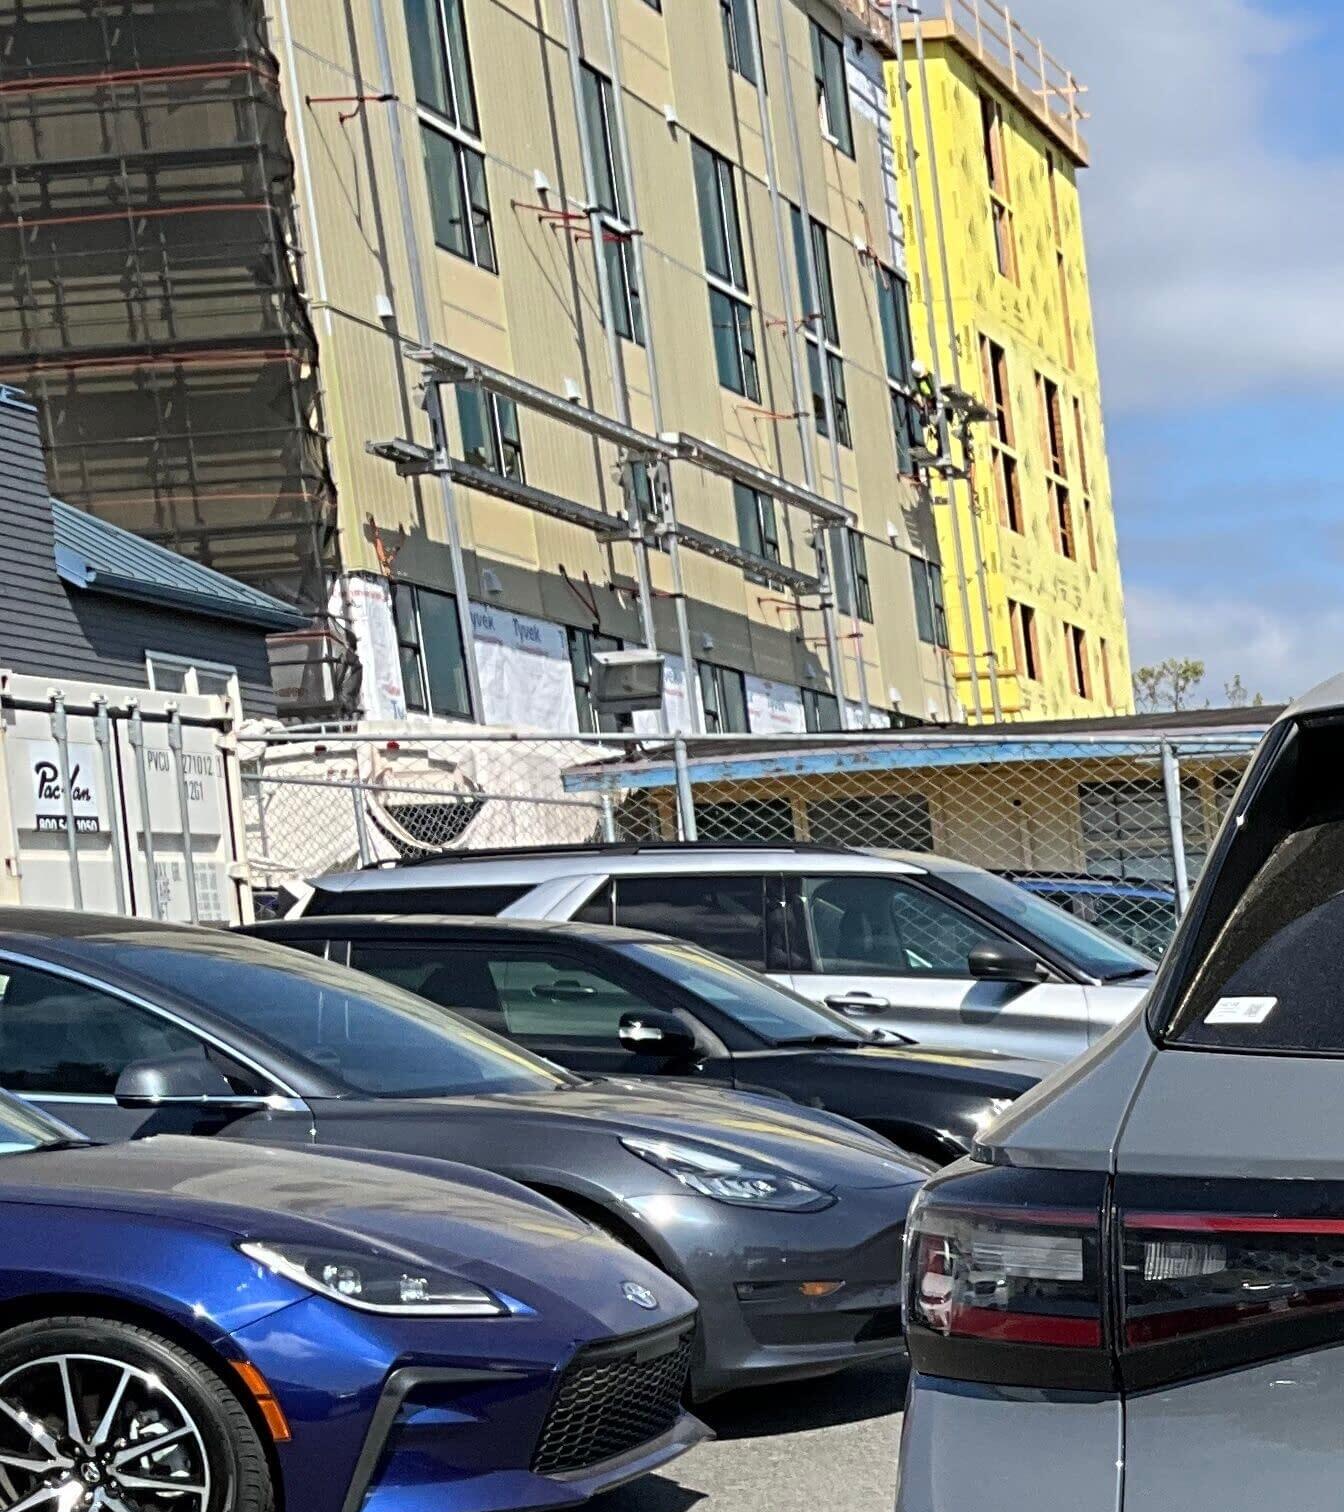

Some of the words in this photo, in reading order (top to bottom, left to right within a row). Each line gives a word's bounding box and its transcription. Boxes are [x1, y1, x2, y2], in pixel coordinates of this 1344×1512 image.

[470, 611, 496, 631] yvek
[512, 618, 542, 643] Tyvek
[147, 750, 170, 772] PVCU
[184, 780, 204, 800] 2G1
